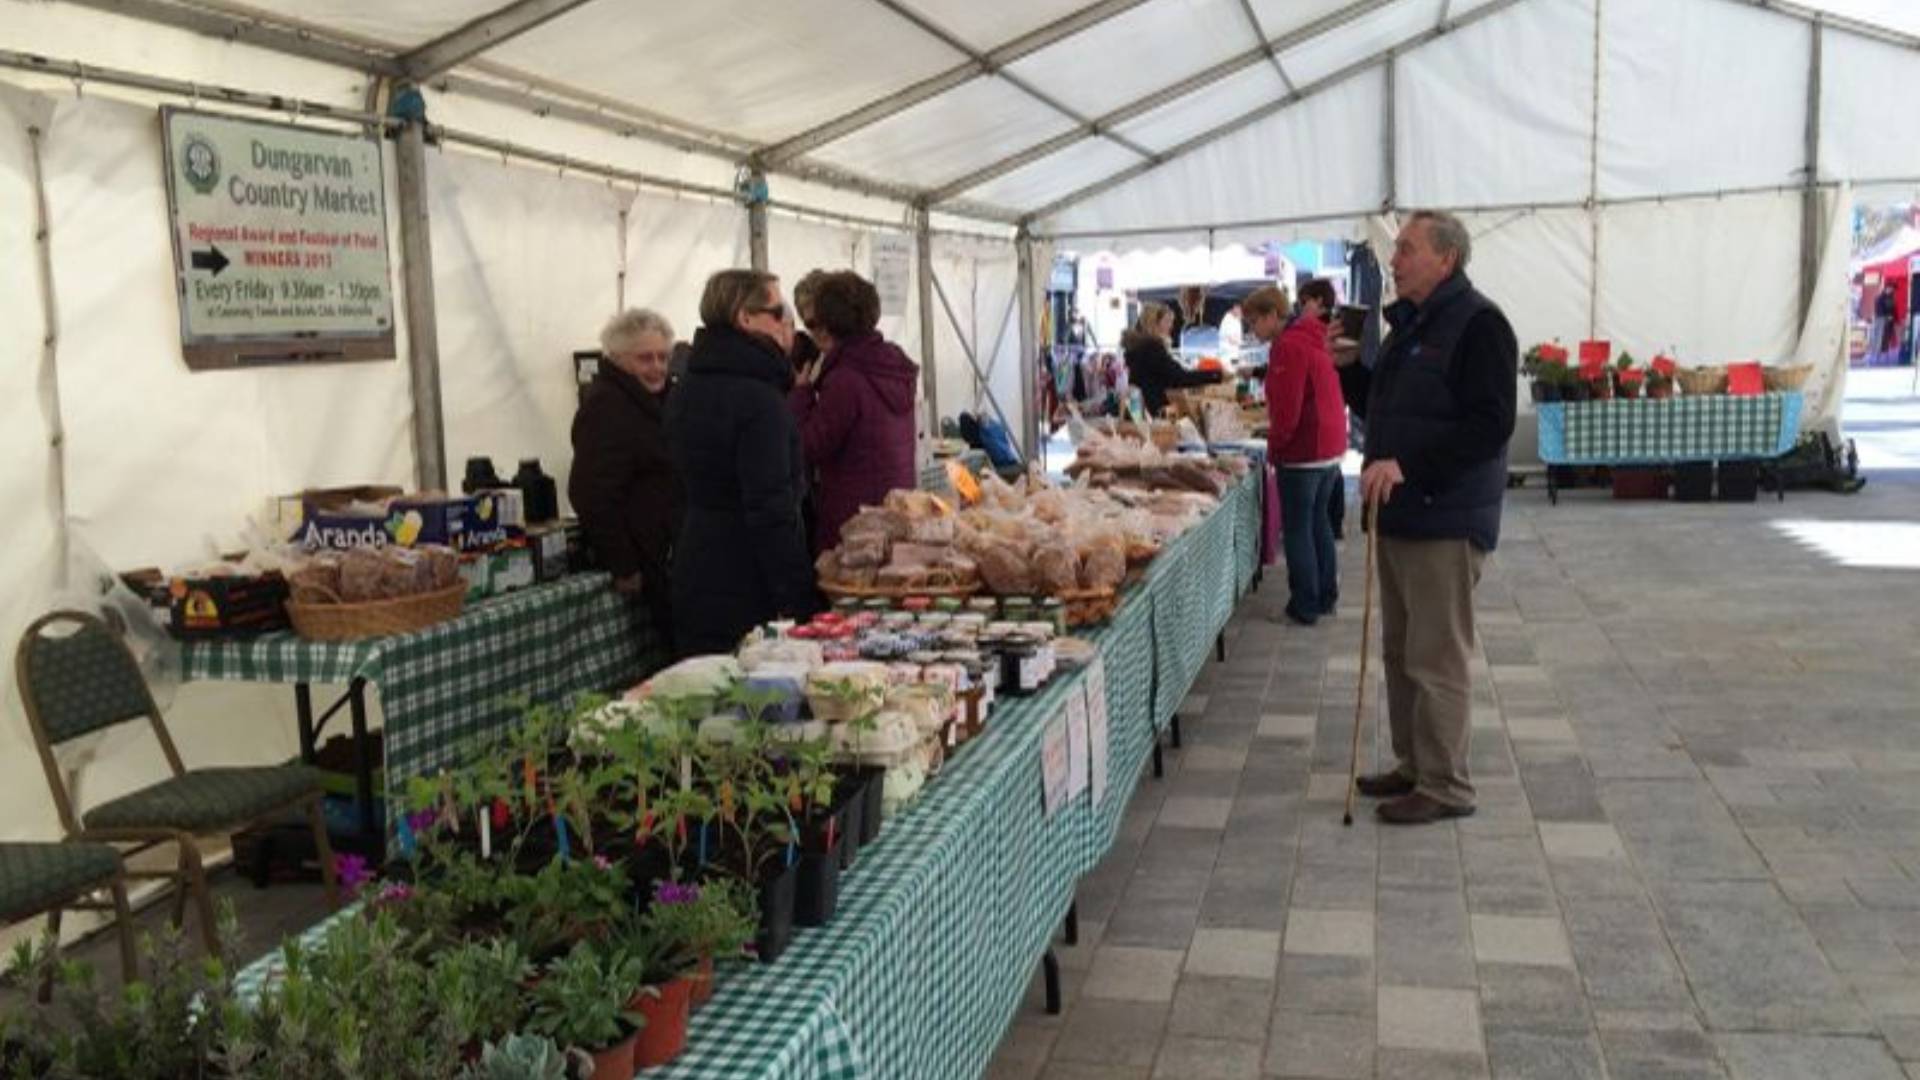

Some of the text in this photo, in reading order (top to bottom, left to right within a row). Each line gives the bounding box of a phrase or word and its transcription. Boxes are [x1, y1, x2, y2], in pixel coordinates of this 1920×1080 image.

[251, 140, 353, 180] Dungarvan
[228, 174, 376, 216] Country Market
[189, 223, 238, 244] Regional
[242, 226, 274, 243] Award
[278, 229, 297, 245] and
[341, 231, 351, 248] of
[244, 249, 300, 268] WINNERS
[195, 279, 231, 305] Every
[235, 279, 273, 305] Friday
[303, 519, 387, 548] Aranda
[468, 526, 507, 546] Aranda
